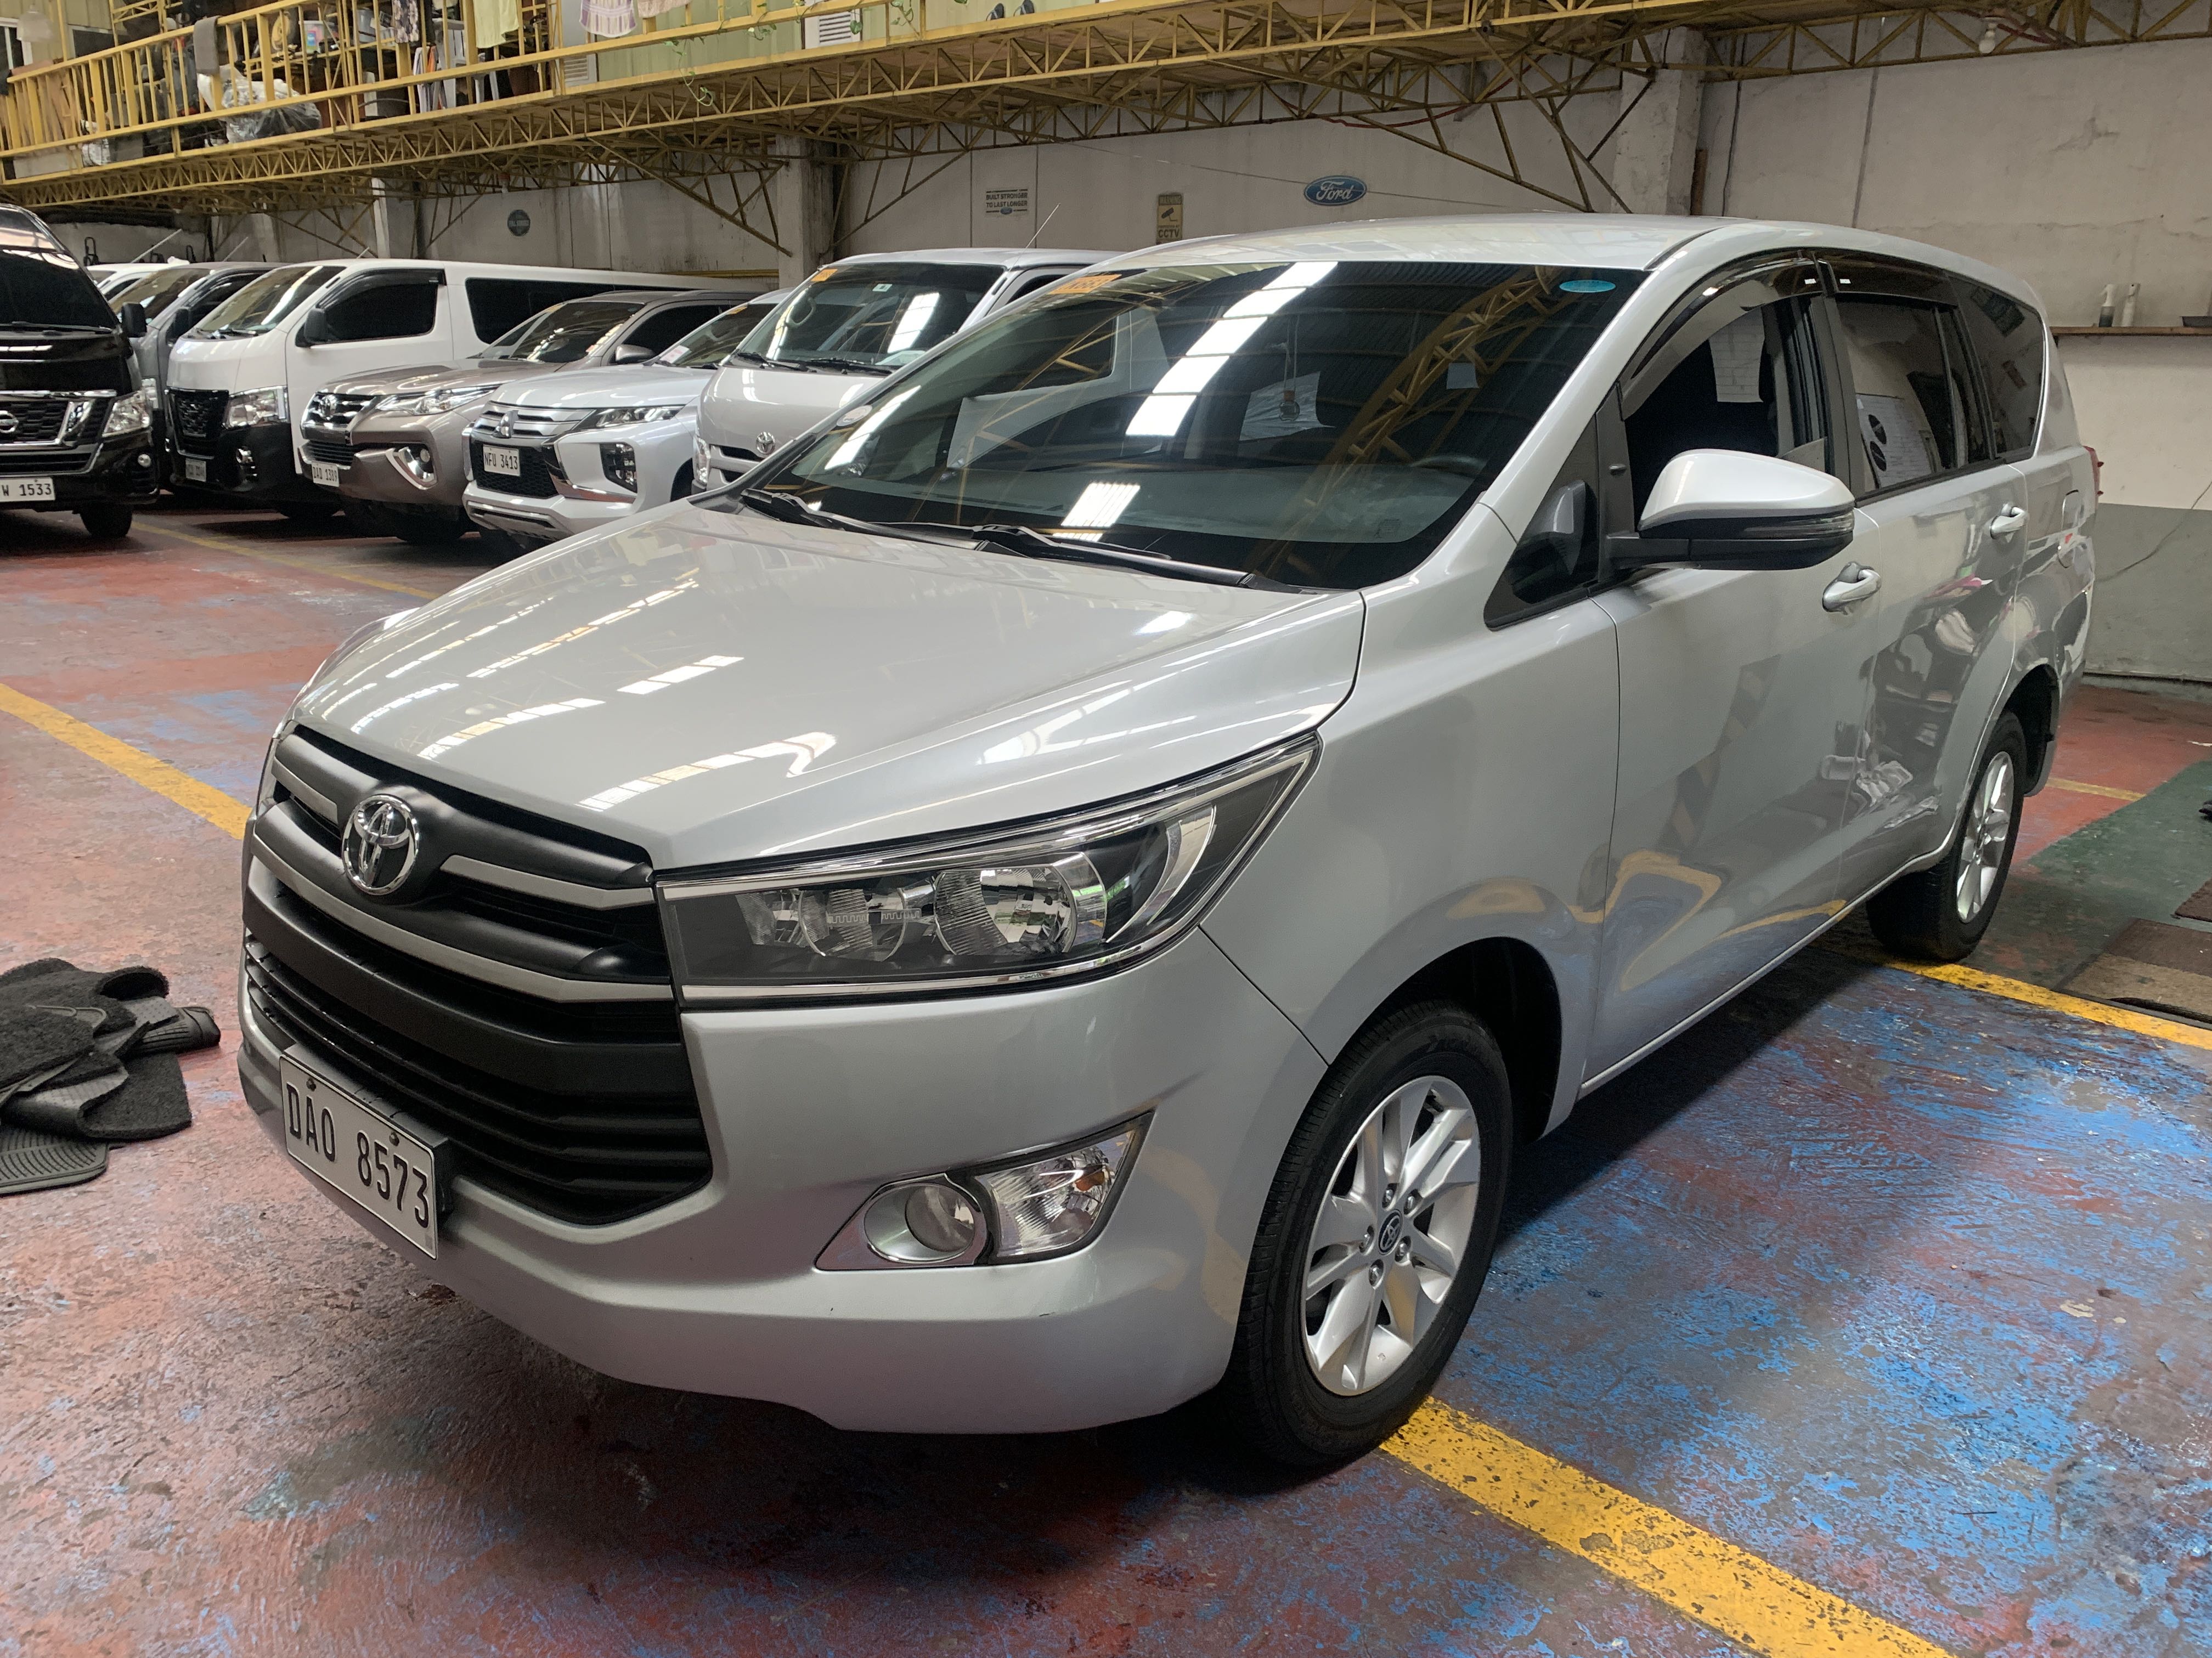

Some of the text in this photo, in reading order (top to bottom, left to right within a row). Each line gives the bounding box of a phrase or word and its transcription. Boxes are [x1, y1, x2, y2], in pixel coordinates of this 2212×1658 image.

[1316, 180, 1355, 201] Ford
[1158, 229, 1180, 237] CCTV
[484, 452, 518, 470] NFU 3413
[19, 483, 52, 496] 1533
[286, 1082, 430, 1229] DAO 8573
